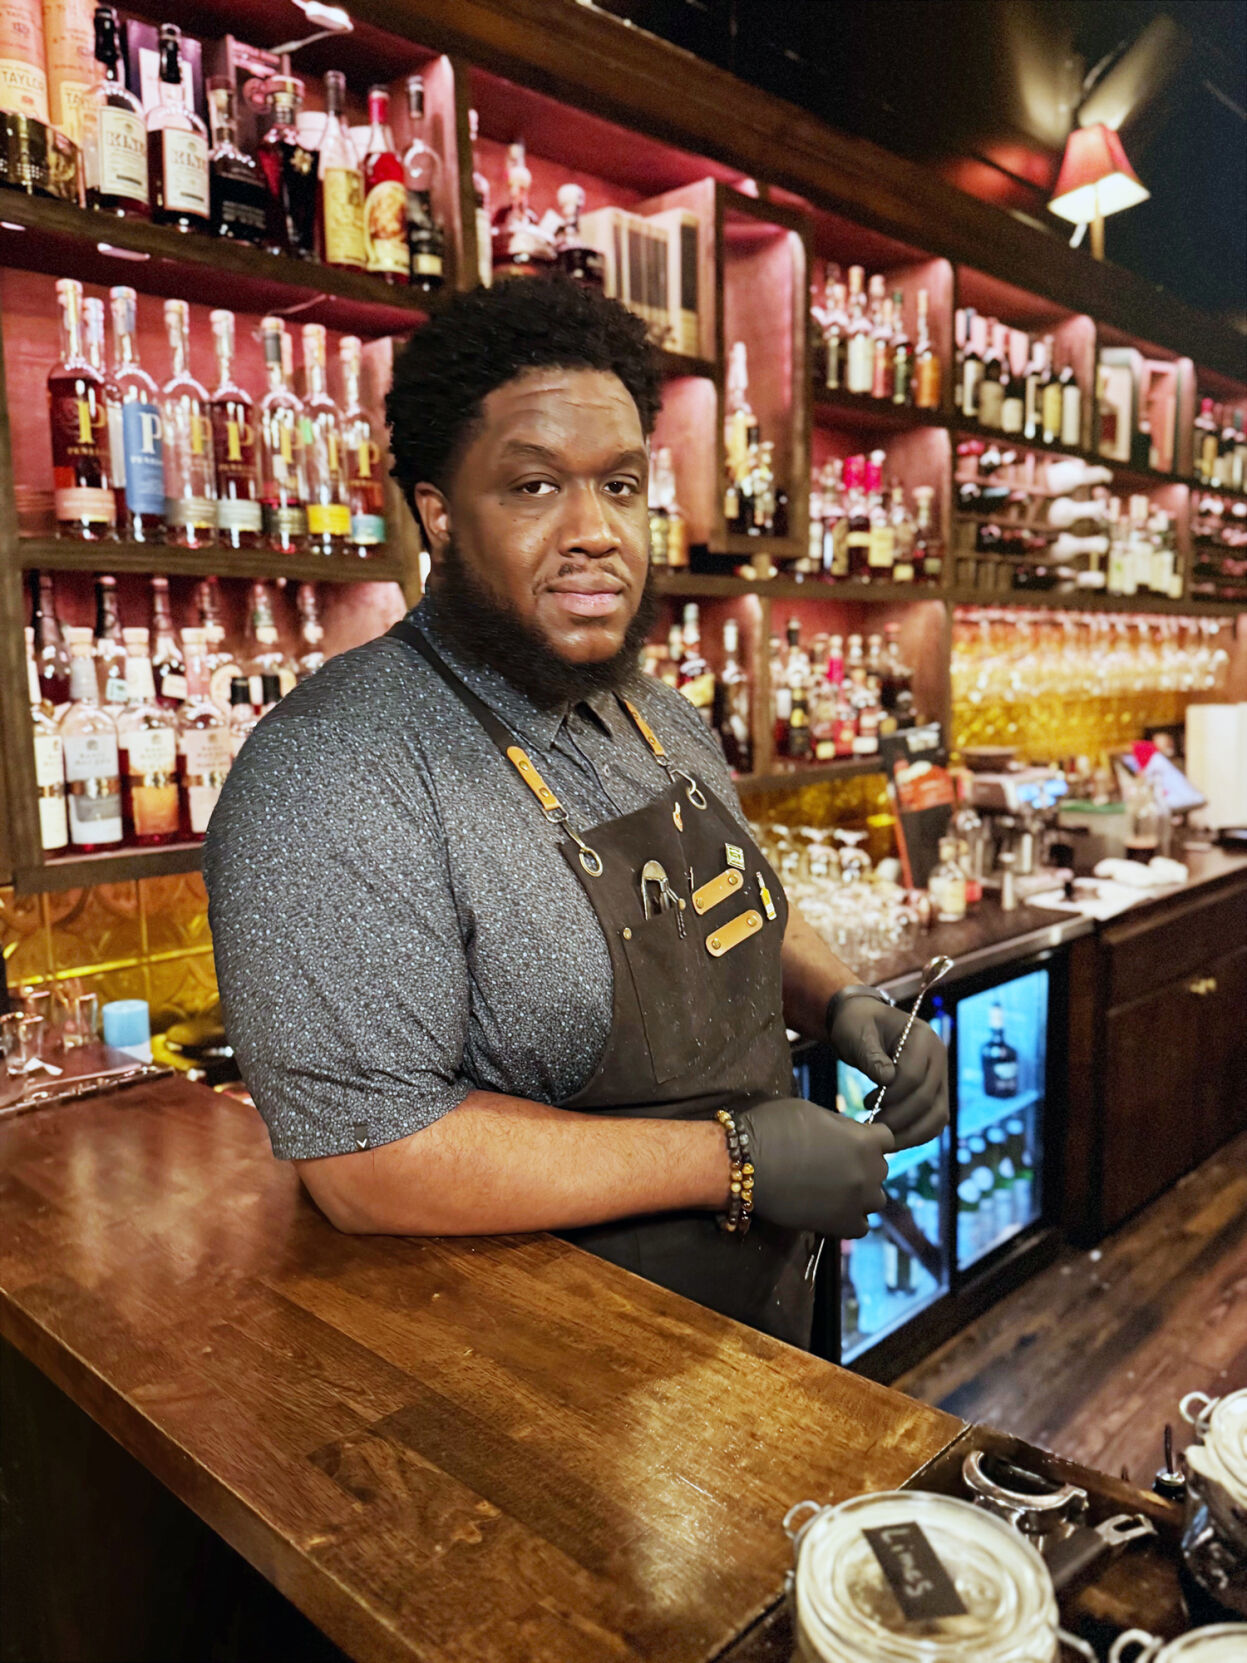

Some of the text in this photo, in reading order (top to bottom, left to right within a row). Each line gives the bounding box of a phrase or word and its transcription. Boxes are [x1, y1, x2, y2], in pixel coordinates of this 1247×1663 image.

[77, 400, 107, 443] P
[139, 412, 163, 454] P
[226, 420, 255, 461] P
[358, 441, 380, 478] P
